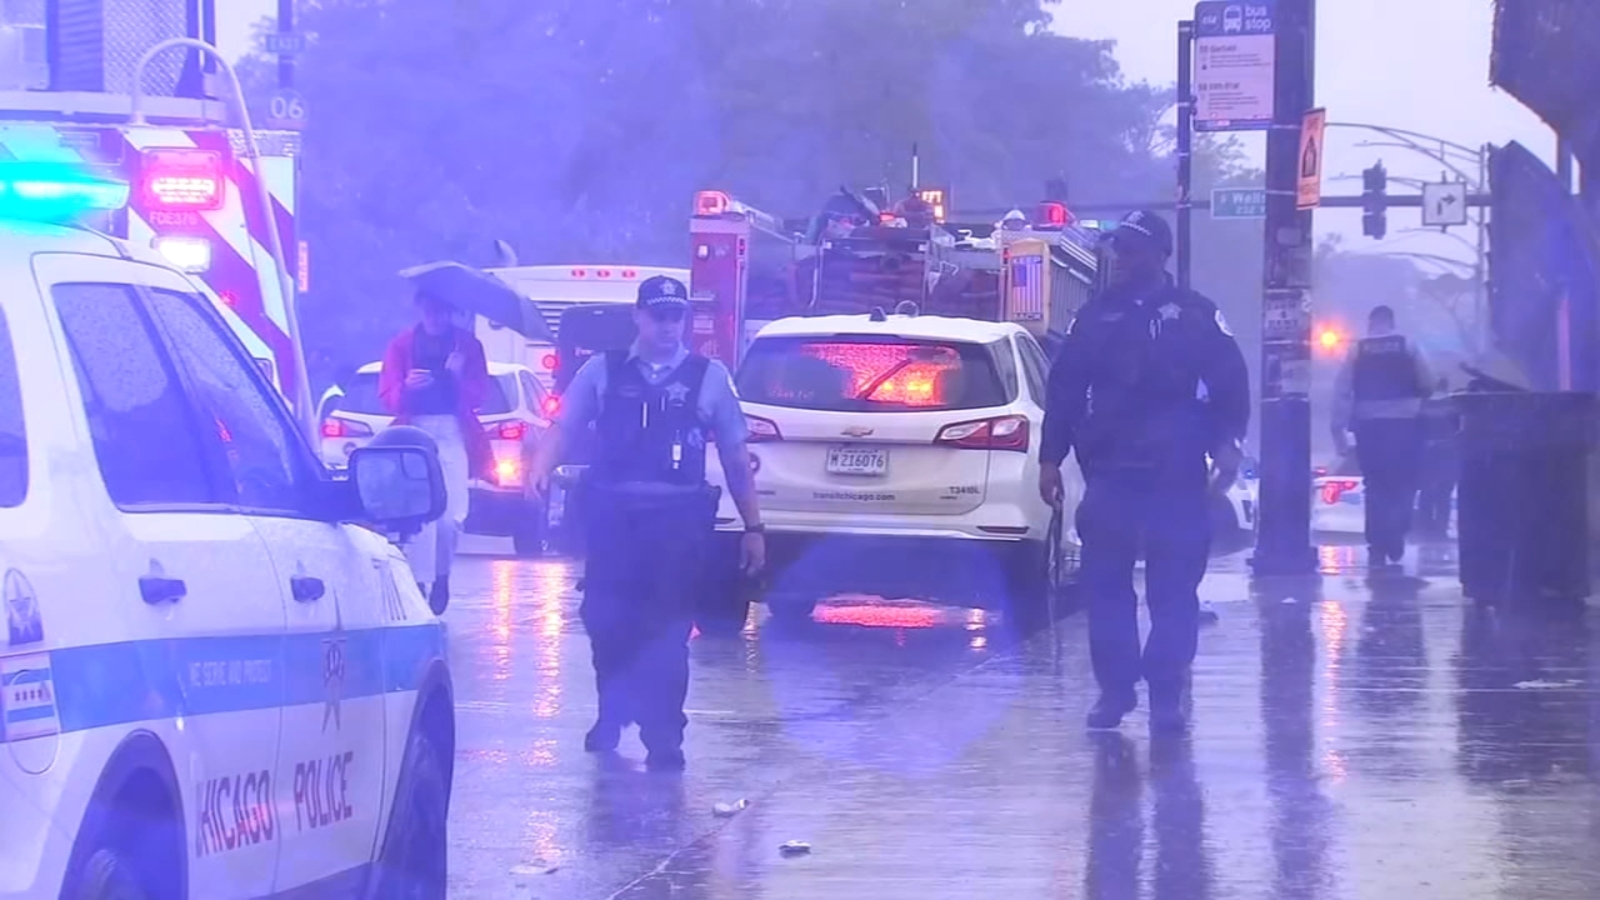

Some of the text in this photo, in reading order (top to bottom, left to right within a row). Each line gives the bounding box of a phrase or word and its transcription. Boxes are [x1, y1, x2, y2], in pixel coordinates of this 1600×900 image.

[1245, 4, 1267, 17] bus
[1245, 17, 1271, 32] stop
[270, 96, 304, 119] 06
[840, 453, 885, 468] 216076
[813, 489, 896, 502] transitchicago.com
[293, 750, 353, 831] POLICE
